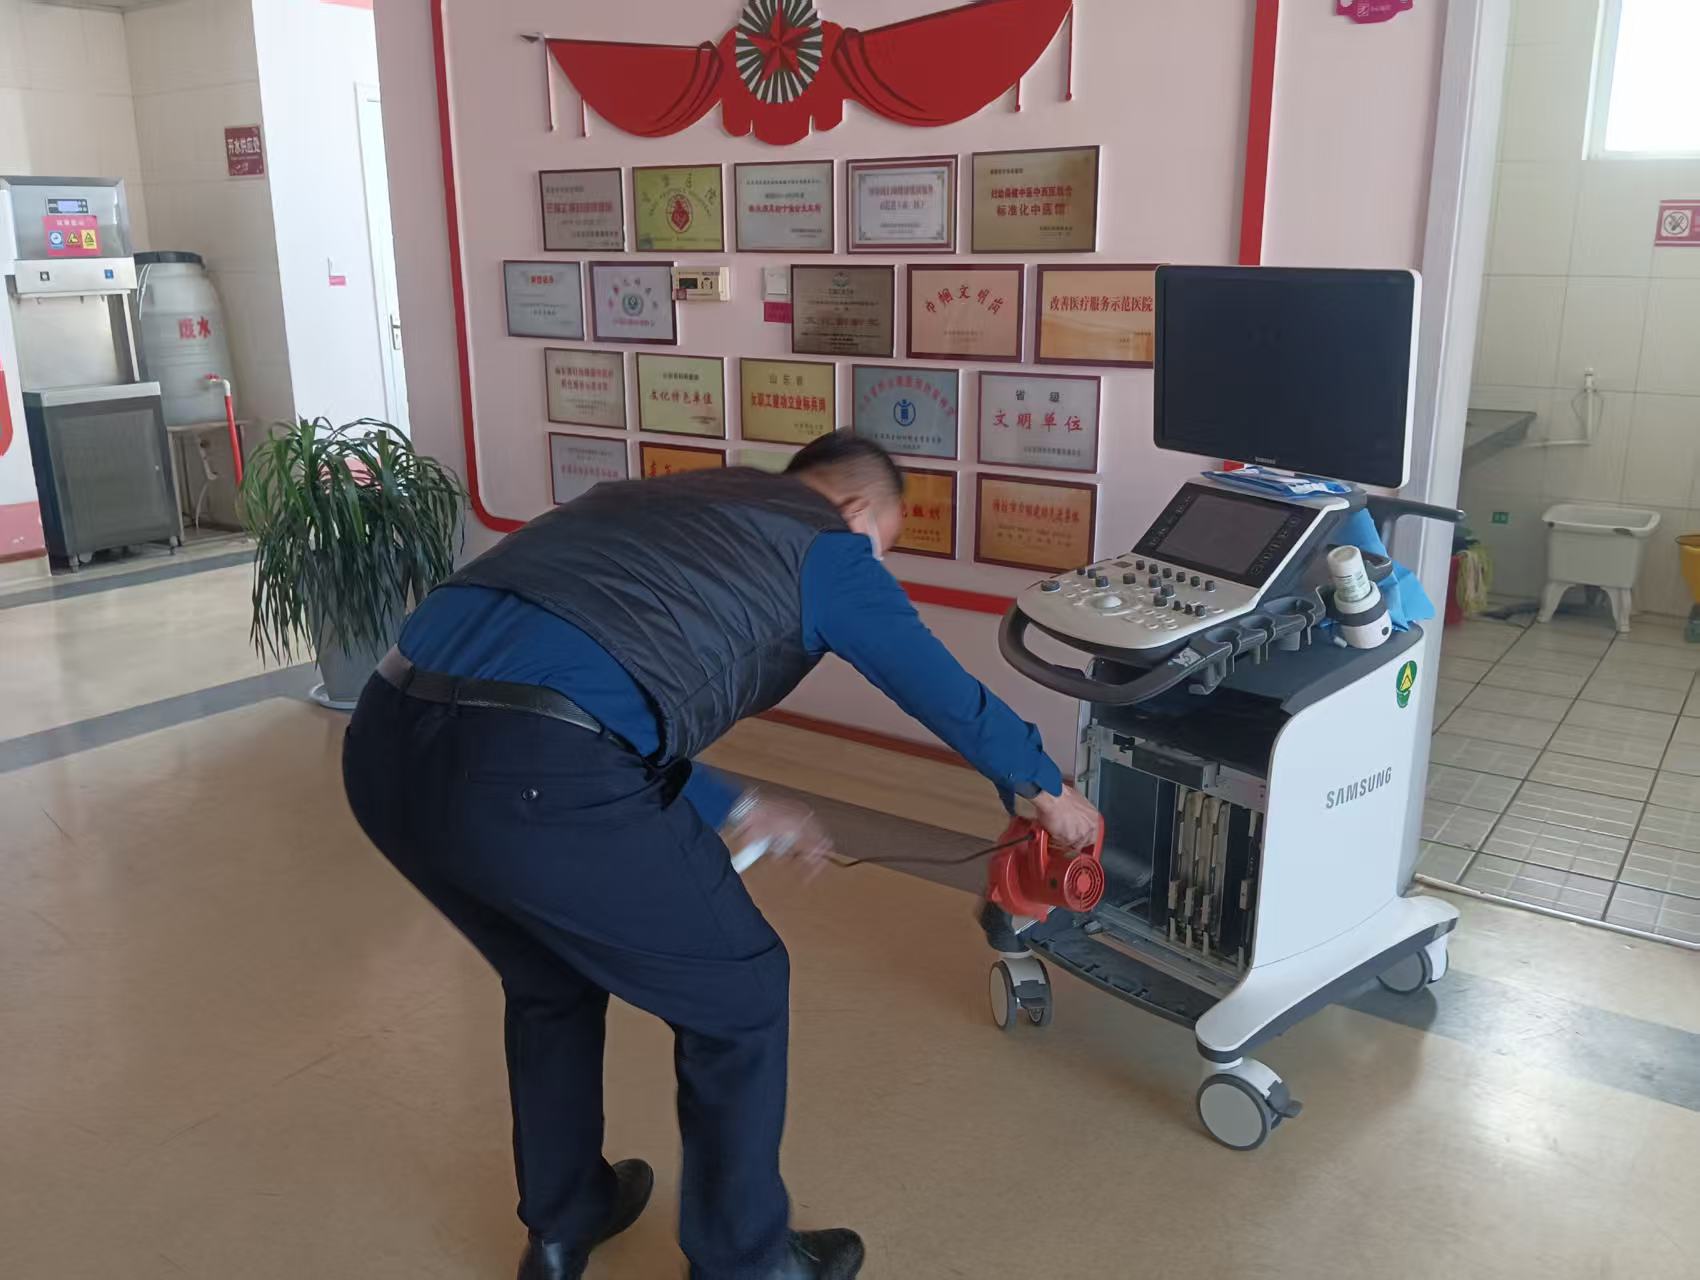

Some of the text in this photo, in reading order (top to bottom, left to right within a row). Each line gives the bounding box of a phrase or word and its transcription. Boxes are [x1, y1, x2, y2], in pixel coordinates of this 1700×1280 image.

[926, 284, 1004, 315] 巾帼文明岗
[1050, 295, 1153, 312] 改善医疗服务示范医院
[1015, 389, 1060, 402] 省级
[992, 410, 1083, 433] 文明单位
[1326, 766, 1393, 809] SAMSUNG
